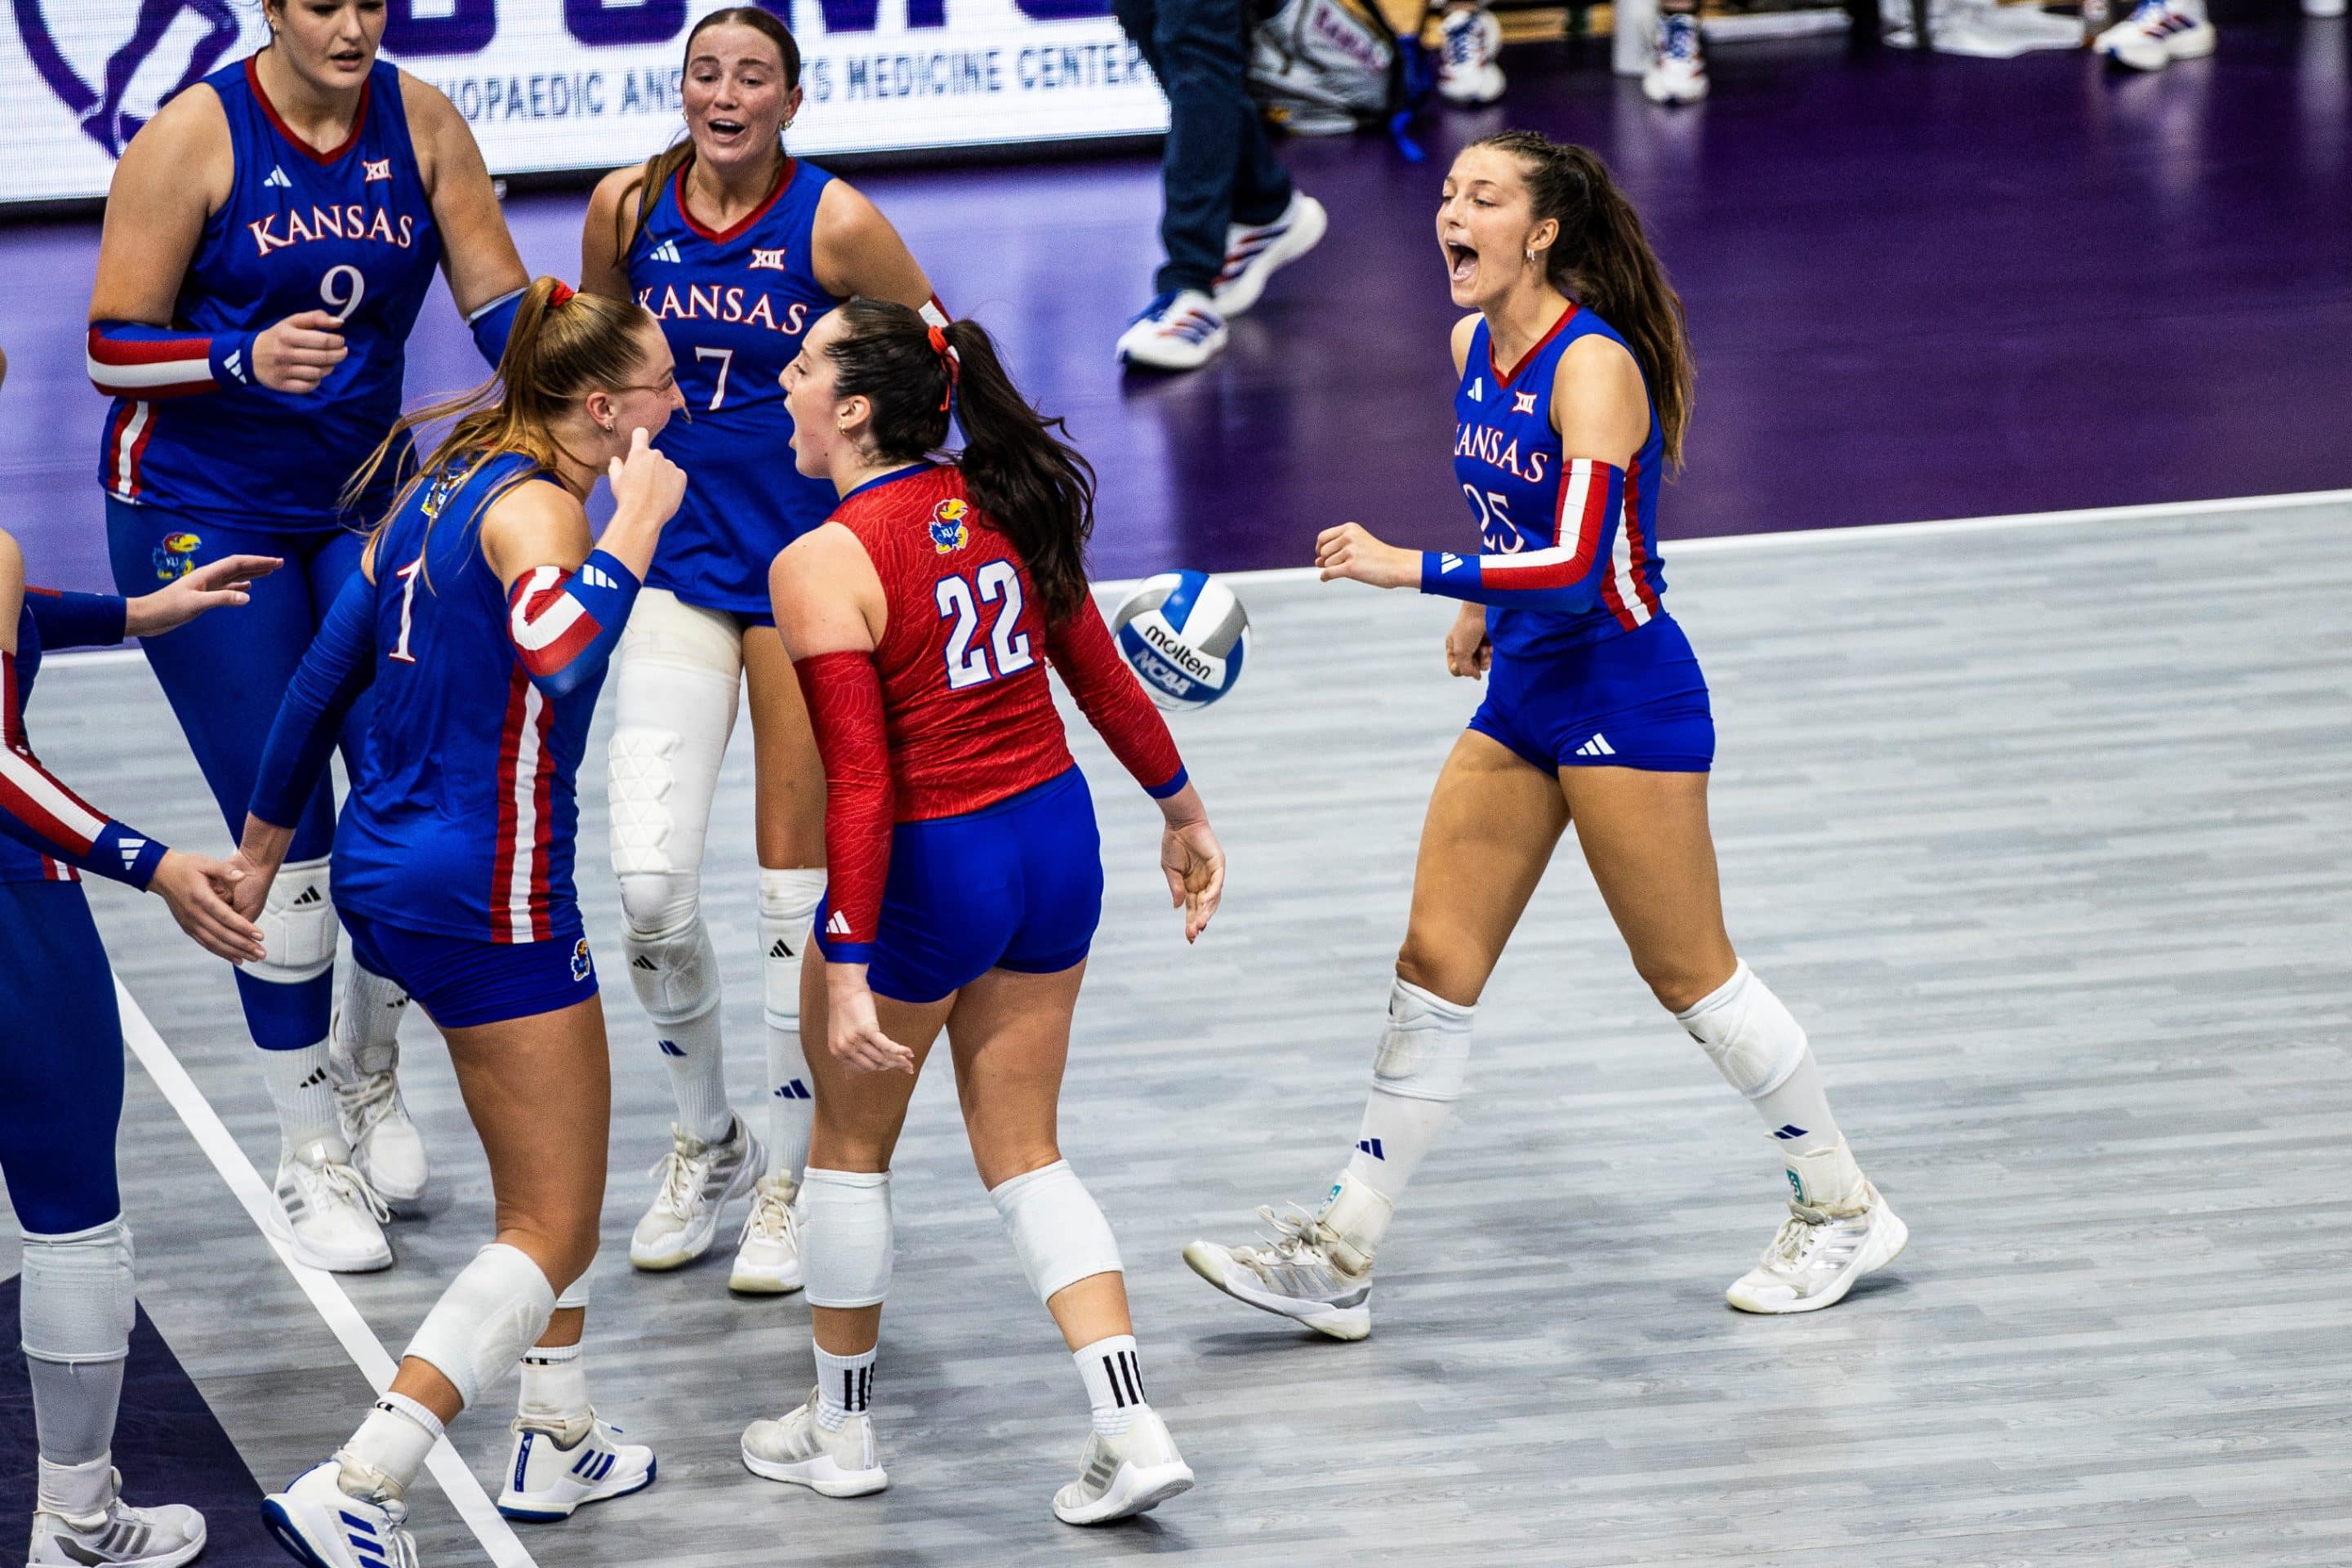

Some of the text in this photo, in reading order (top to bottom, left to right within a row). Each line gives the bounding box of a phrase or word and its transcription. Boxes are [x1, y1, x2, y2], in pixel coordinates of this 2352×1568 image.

[846, 50, 1004, 101] MEDICINE
[247, 204, 413, 258] KANSAS
[319, 264, 365, 324] 9
[638, 283, 808, 336] KANSAS
[694, 345, 733, 411] 7
[1462, 483, 1526, 555] 25
[389, 556, 424, 664] 1
[934, 558, 1036, 691] 22
[1145, 626, 1211, 679] molten
